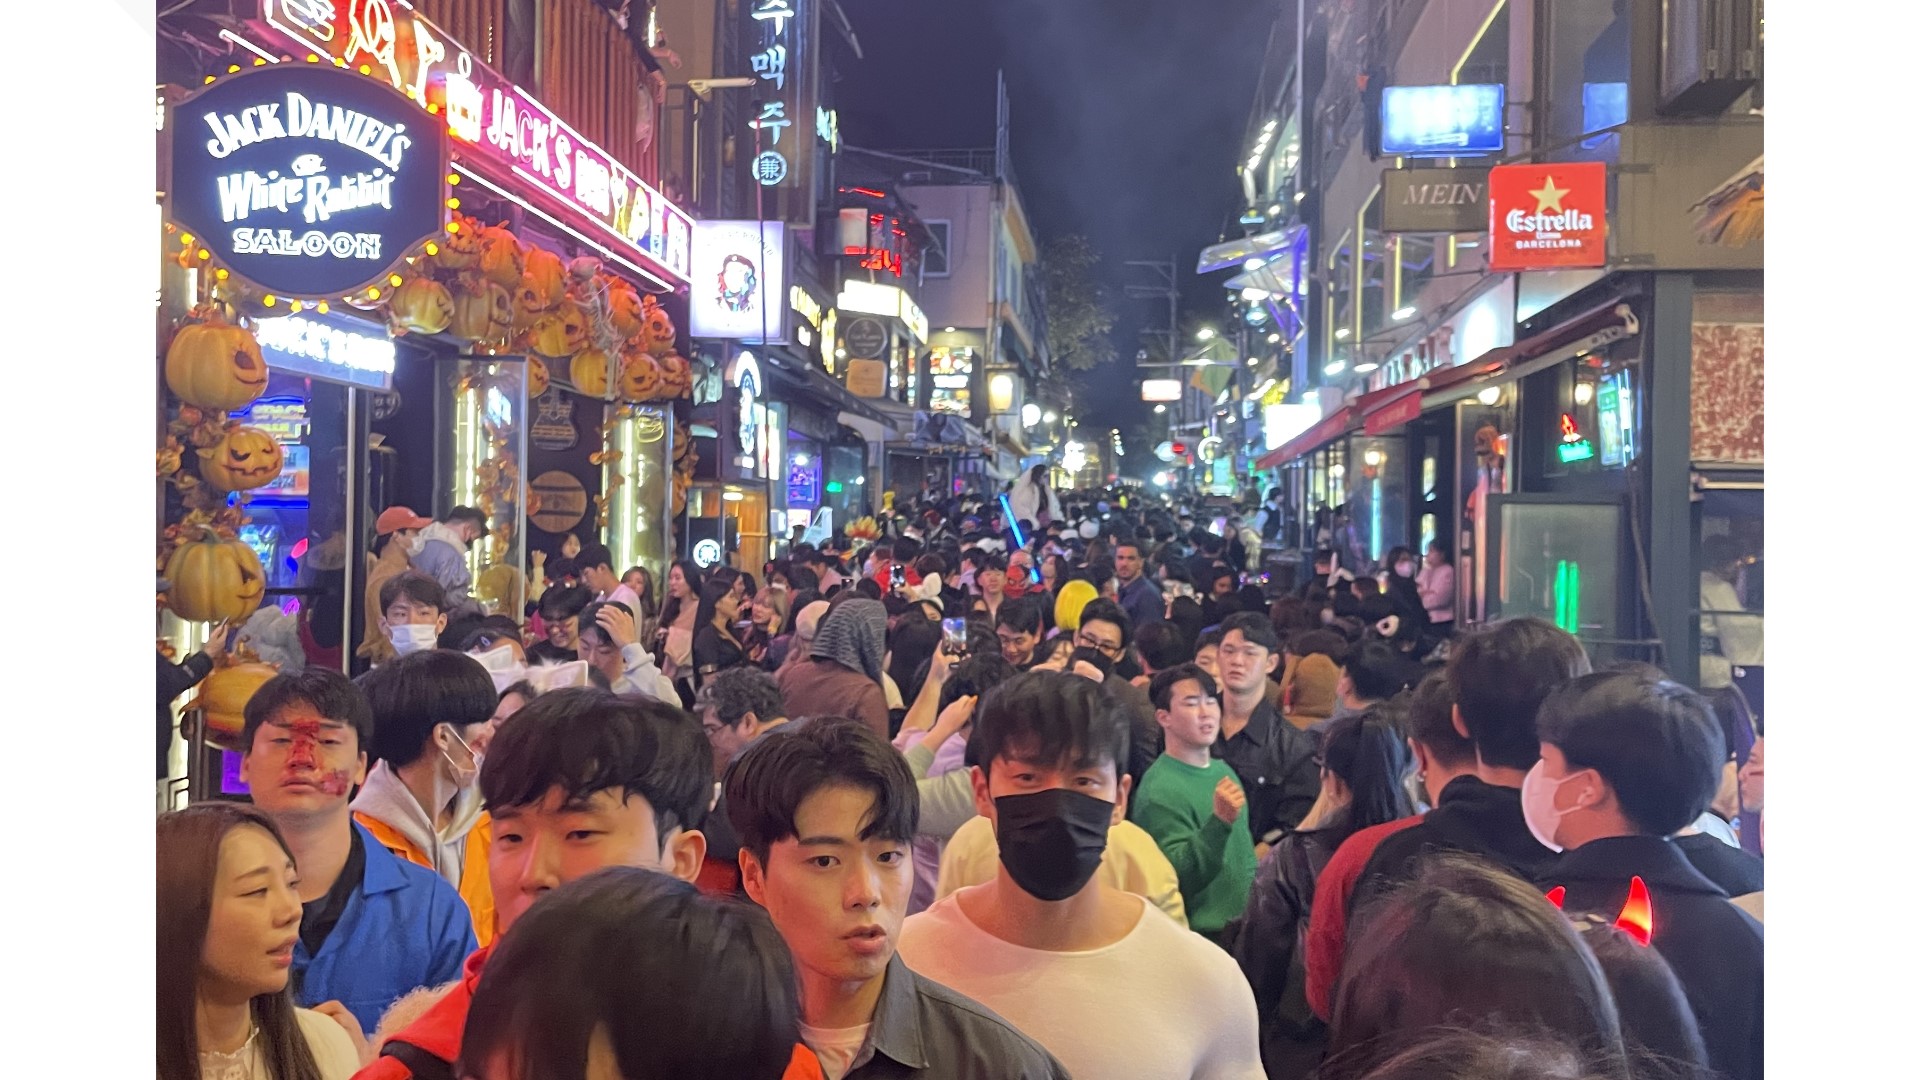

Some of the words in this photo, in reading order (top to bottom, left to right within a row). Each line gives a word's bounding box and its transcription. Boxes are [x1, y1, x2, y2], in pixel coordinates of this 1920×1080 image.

[203, 103, 288, 159] JACK
[286, 91, 412, 172] DANIEL'S
[486, 88, 572, 190] JACK'S
[216, 170, 304, 223] White
[302, 167, 396, 224] Rabbit
[1402, 183, 1484, 206] MEIN
[1505, 208, 1594, 234] Estrella
[232, 226, 382, 260] SALOON
[1515, 239, 1582, 250] BARCELONA
